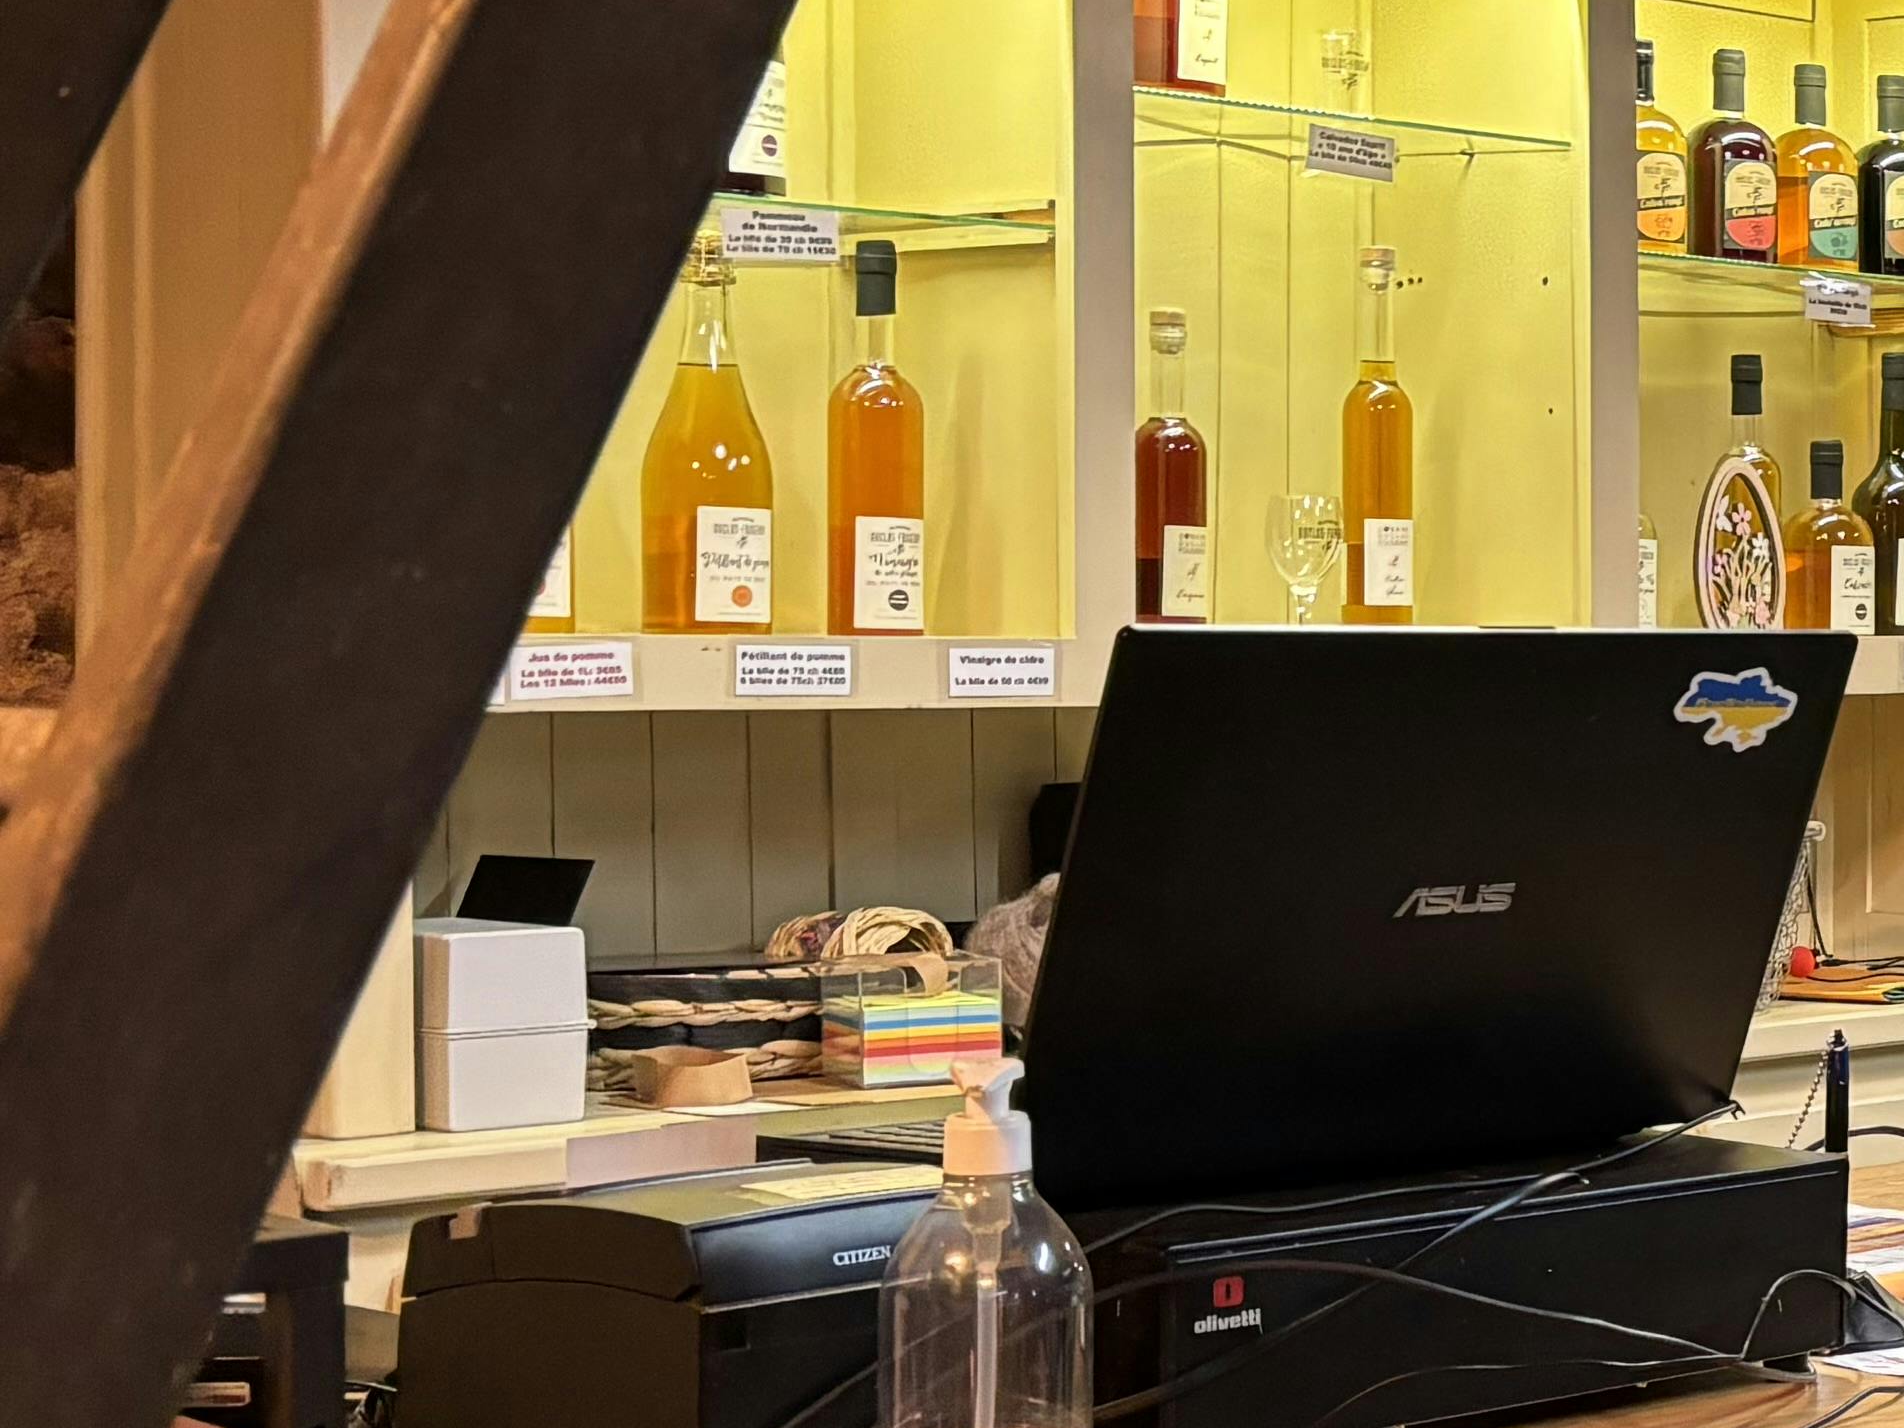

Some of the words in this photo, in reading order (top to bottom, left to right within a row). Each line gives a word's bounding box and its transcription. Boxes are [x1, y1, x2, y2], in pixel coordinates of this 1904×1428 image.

[528, 652, 550, 663] Jus
[571, 652, 615, 663] pomme
[1392, 882, 1517, 919] ASUS
[832, 1244, 892, 1267] CITIZEN
[1193, 1307, 1262, 1334] olivetti
